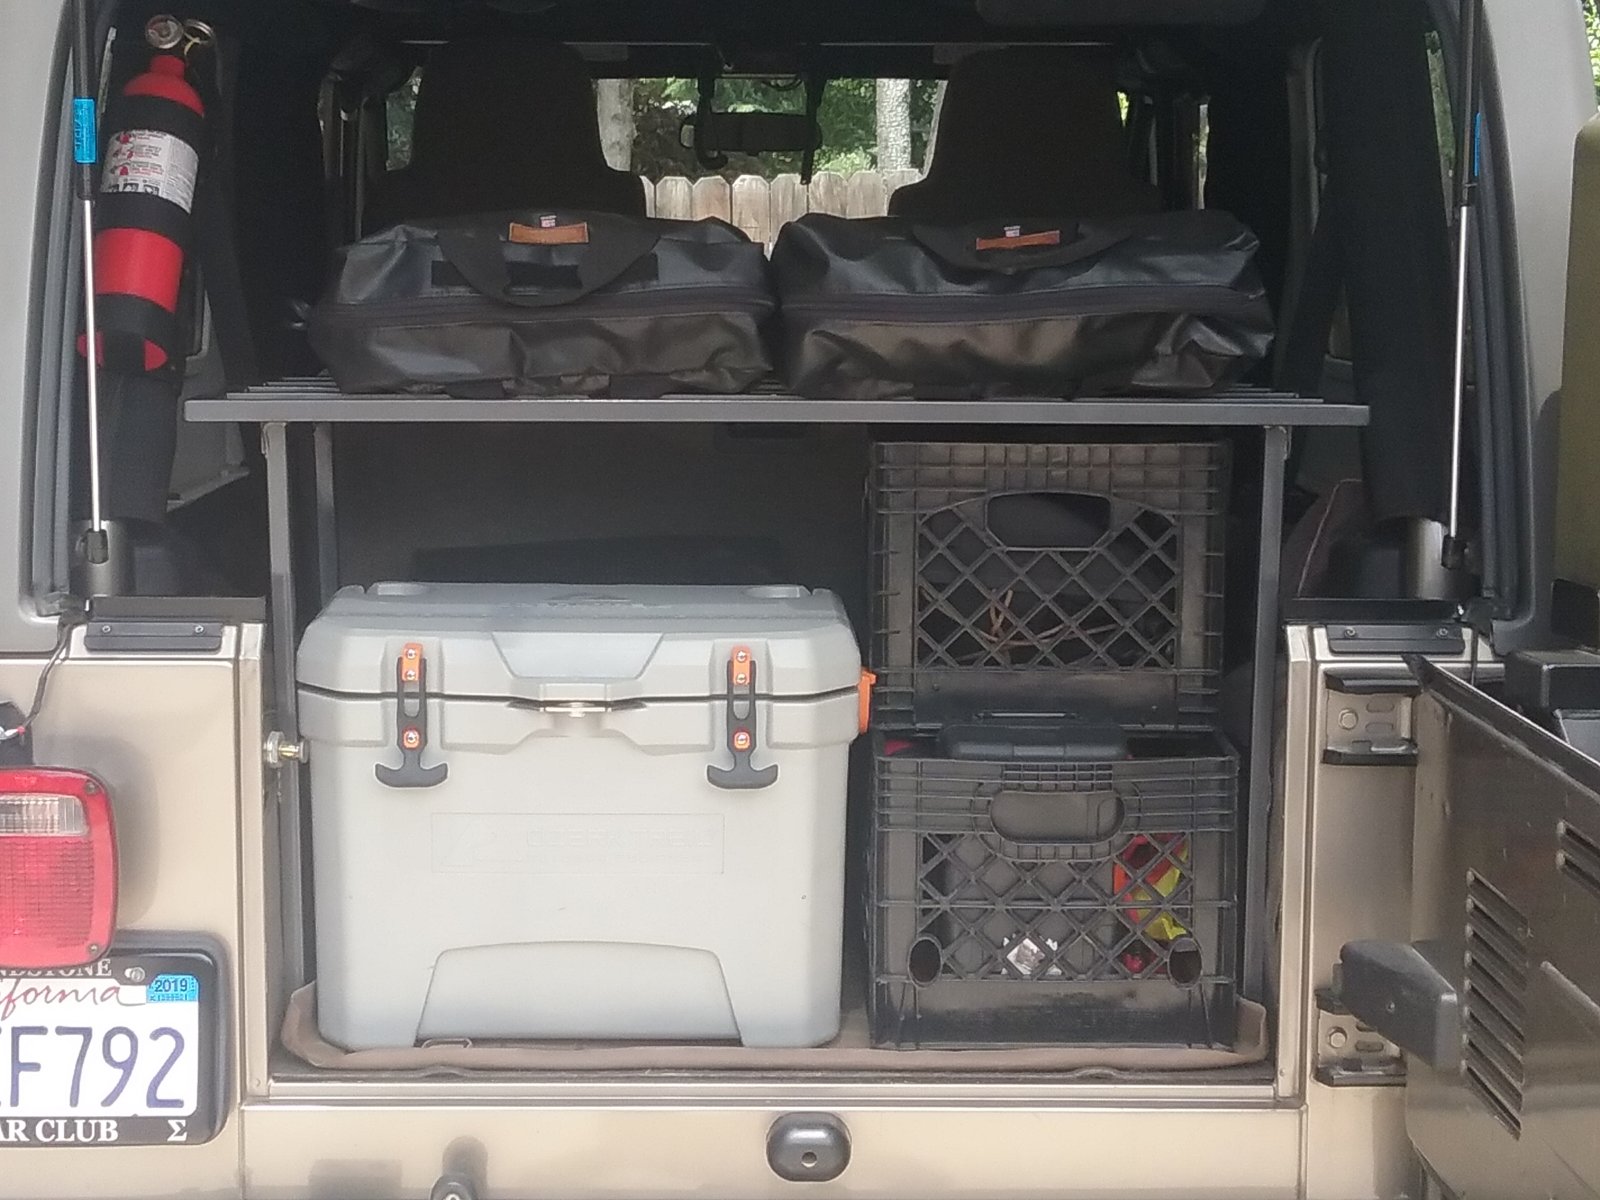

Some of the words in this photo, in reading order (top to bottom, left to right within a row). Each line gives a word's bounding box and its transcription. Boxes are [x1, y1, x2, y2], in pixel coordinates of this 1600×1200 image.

[154, 978, 187, 993] 2019
[0, 1026, 185, 1108] F792
[36, 1119, 118, 1142] CLUB
